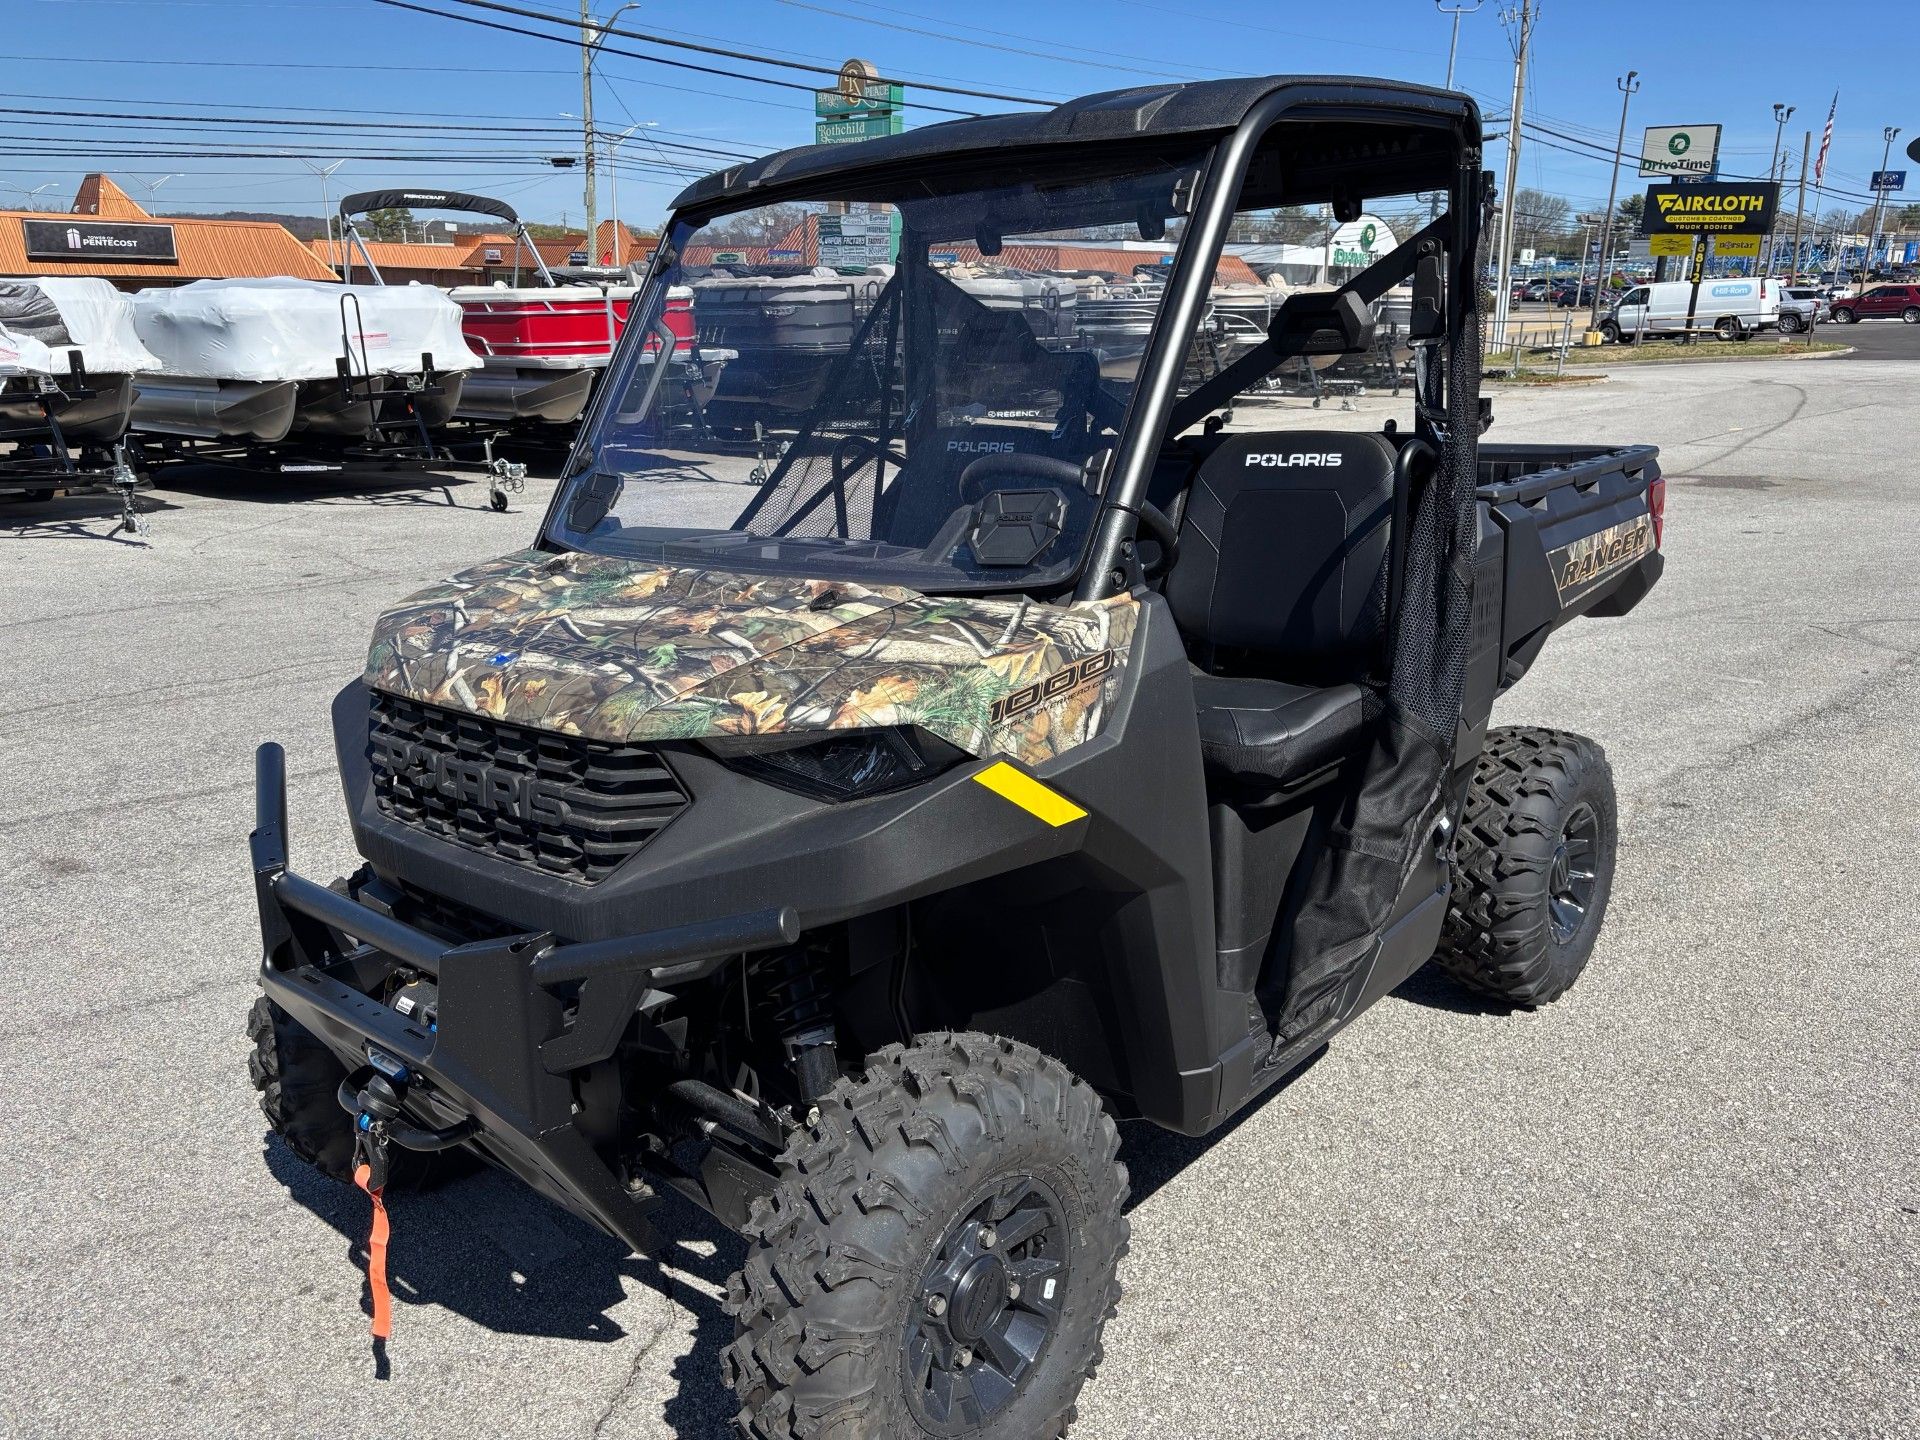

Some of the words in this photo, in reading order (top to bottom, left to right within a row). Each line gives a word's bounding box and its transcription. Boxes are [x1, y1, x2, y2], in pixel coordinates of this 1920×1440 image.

[864, 84, 889, 98] PLACE
[818, 121, 866, 138] Rothchild
[1641, 158, 1711, 171] DriveTime
[1656, 194, 1764, 214] FAIRCLOTH
[83, 238, 138, 247] PENTECOST
[582, 265, 622, 274] Ranger
[1692, 242, 1705, 283] 8812
[996, 410, 1040, 418] REGENCY
[946, 441, 1015, 453] POLARIS
[1245, 453, 1342, 467] POLARIS
[1559, 524, 1648, 591] RANGER
[989, 647, 1115, 726] 1000
[386, 734, 572, 827] POLARIS
